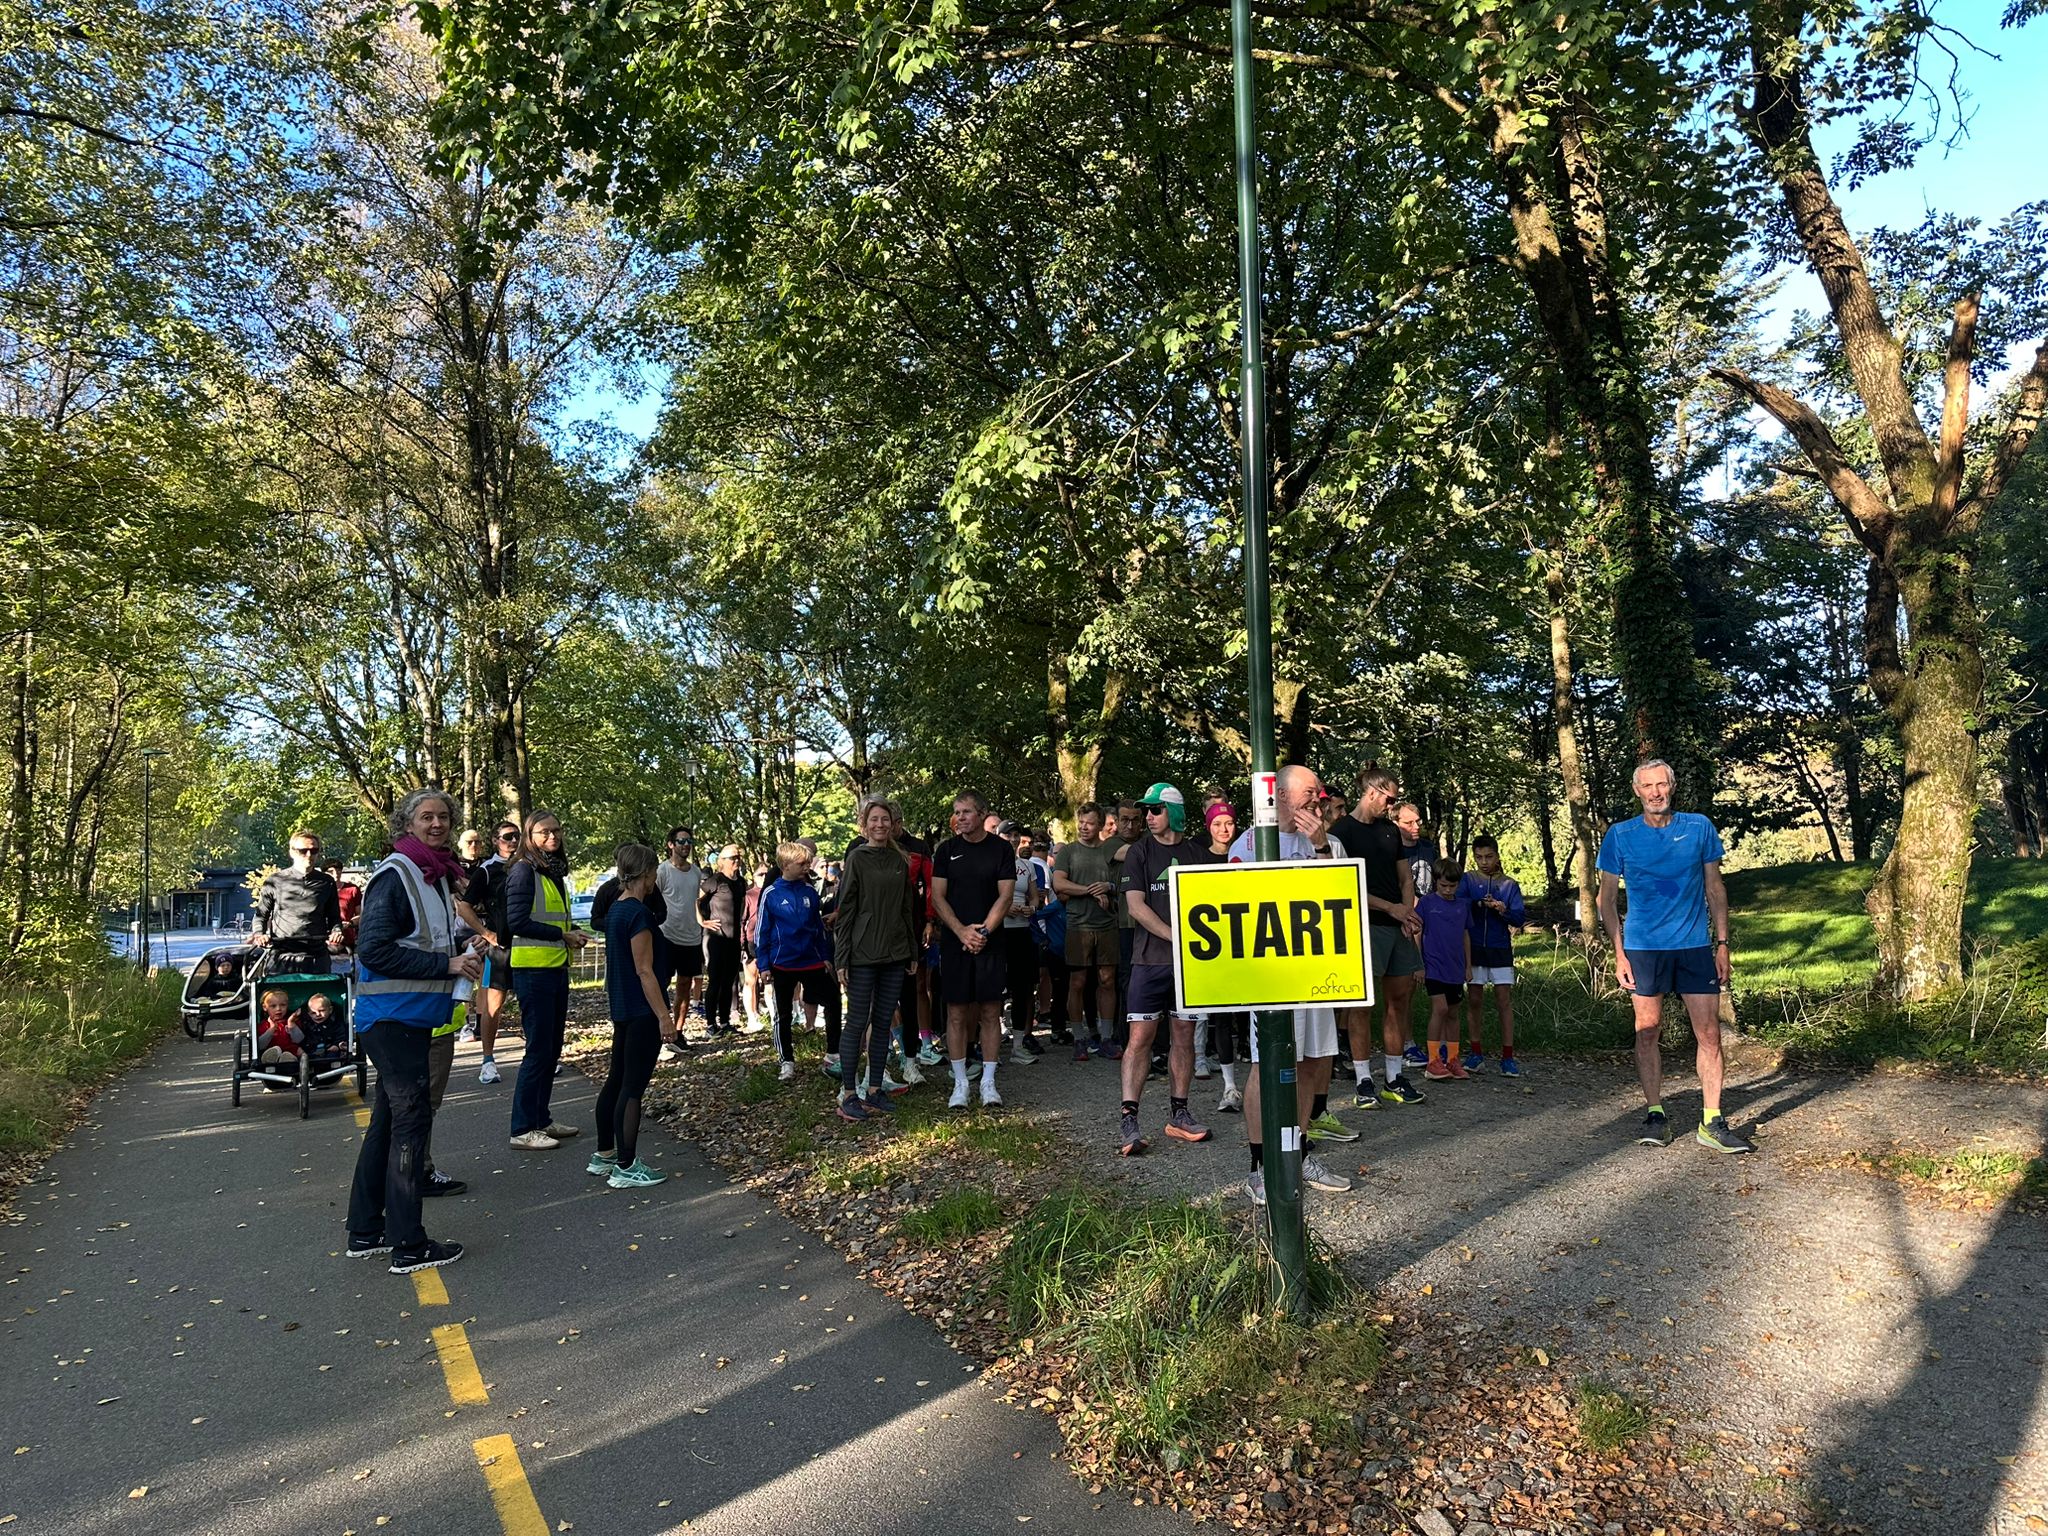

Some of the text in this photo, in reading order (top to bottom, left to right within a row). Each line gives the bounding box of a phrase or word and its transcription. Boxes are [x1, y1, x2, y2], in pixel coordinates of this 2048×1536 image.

[1150, 883, 1165, 892] RUN
[1188, 899, 1352, 961] START
[1311, 977, 1360, 997] parkrun
